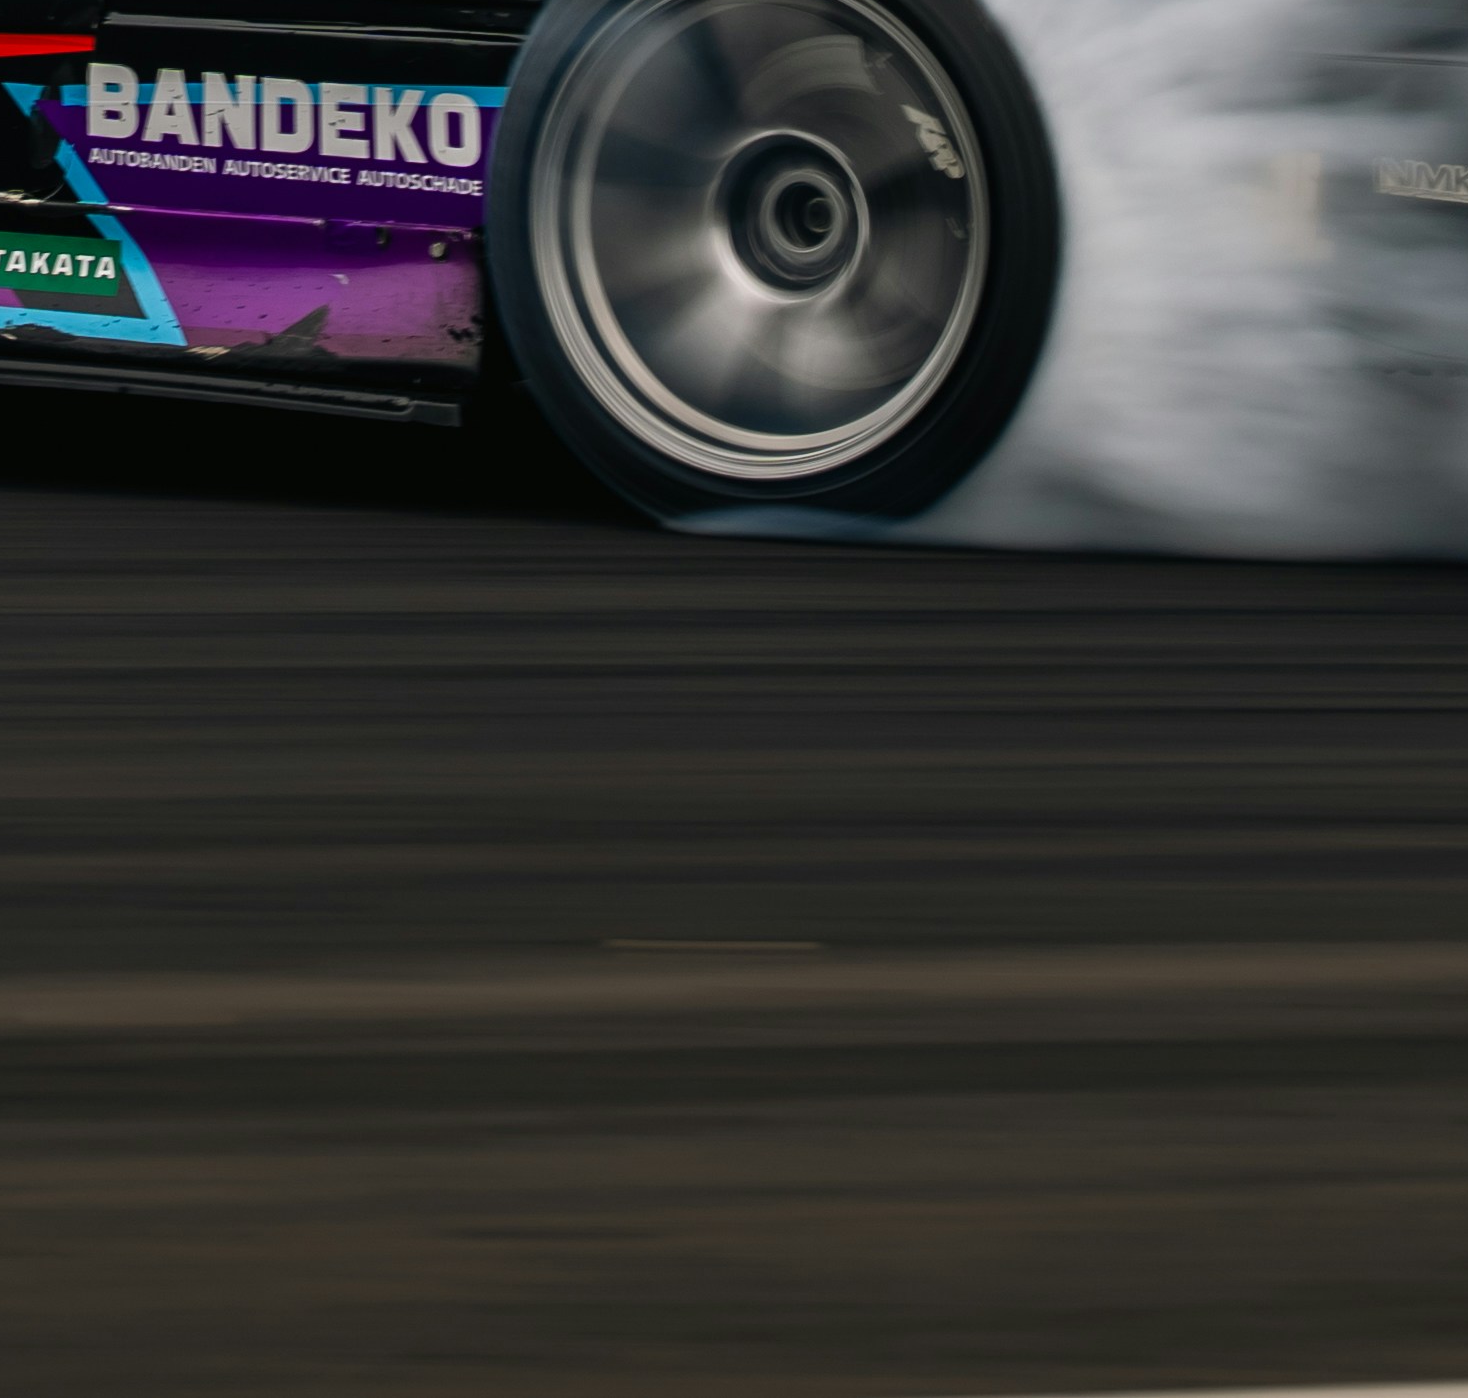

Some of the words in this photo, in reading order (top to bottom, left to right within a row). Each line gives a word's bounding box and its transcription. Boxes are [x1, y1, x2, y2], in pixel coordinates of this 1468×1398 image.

[87, 62, 482, 167] BANDEKO
[89, 147, 217, 173] AUTOBANDEN
[222, 159, 351, 186] AUTOSERVICE
[356, 170, 484, 197] AUTOSCHADE
